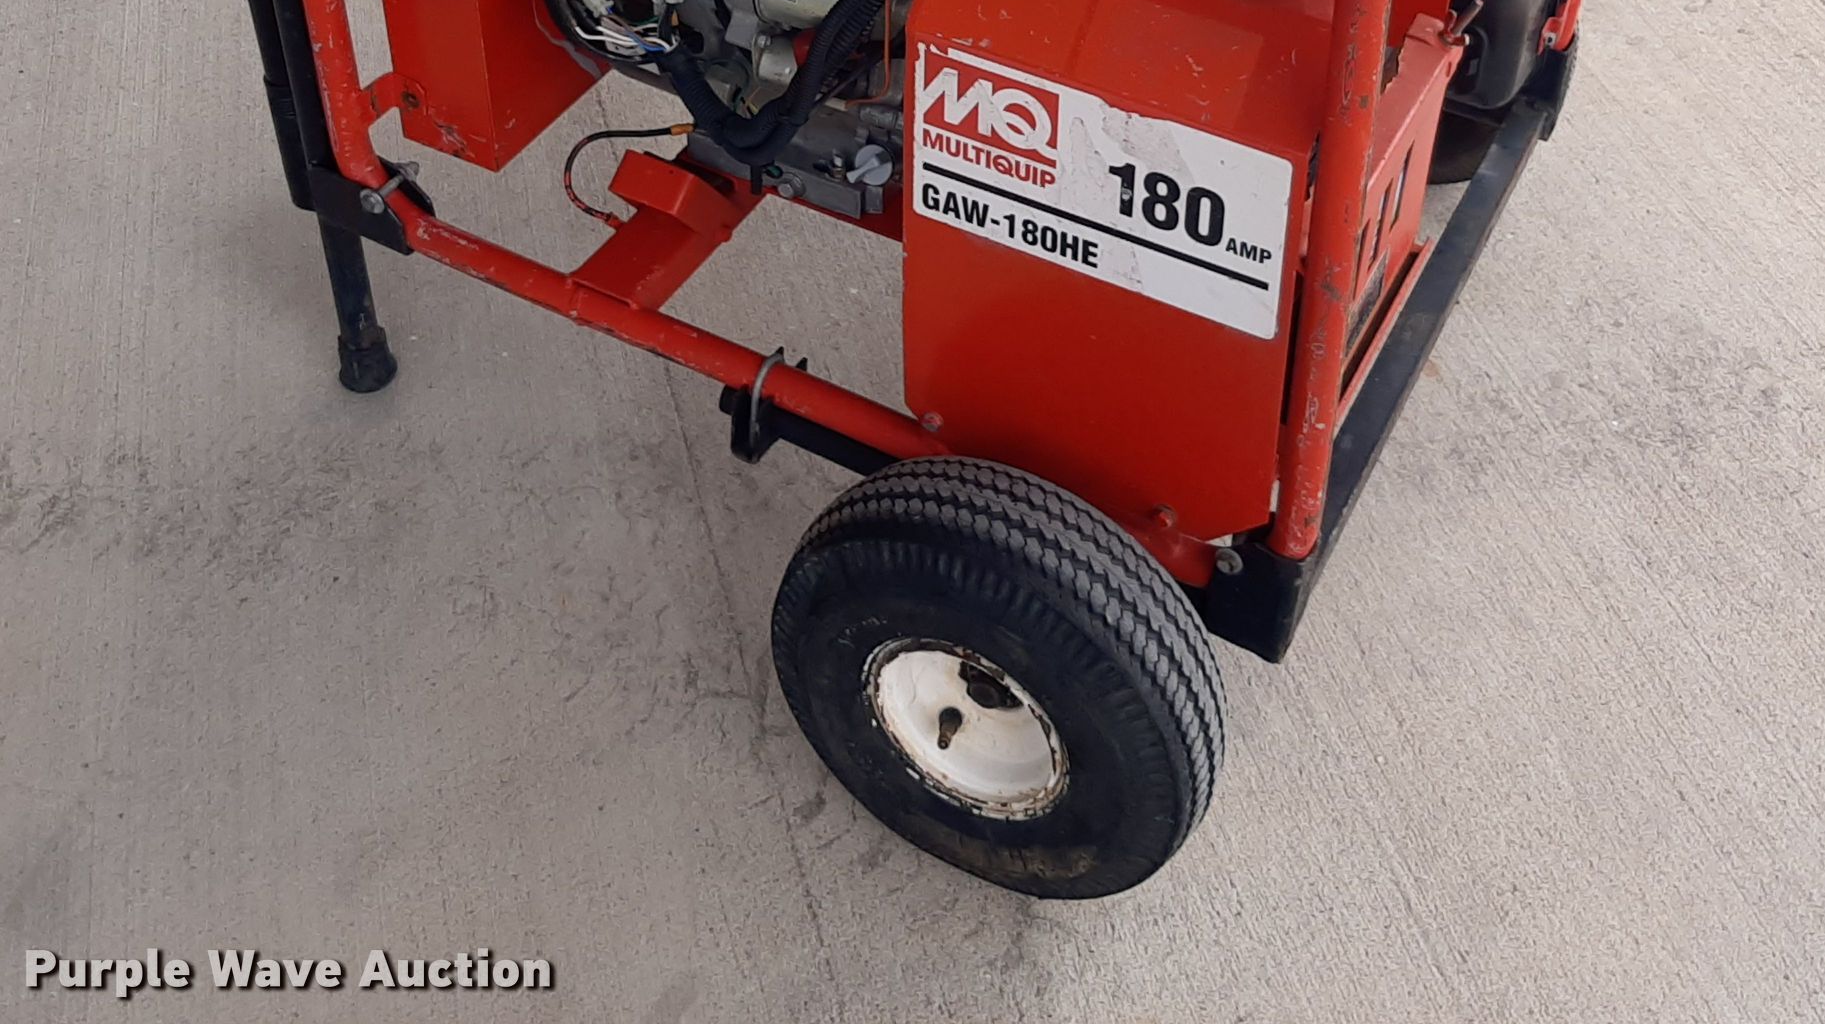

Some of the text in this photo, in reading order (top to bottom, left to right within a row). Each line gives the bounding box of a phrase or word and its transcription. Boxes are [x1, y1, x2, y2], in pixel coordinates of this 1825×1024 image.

[923, 67, 1056, 160] MQ
[923, 129, 1057, 189] MULTIQUIP
[922, 182, 1099, 268] GAW-180HE
[1108, 163, 1272, 264] 180 AMP
